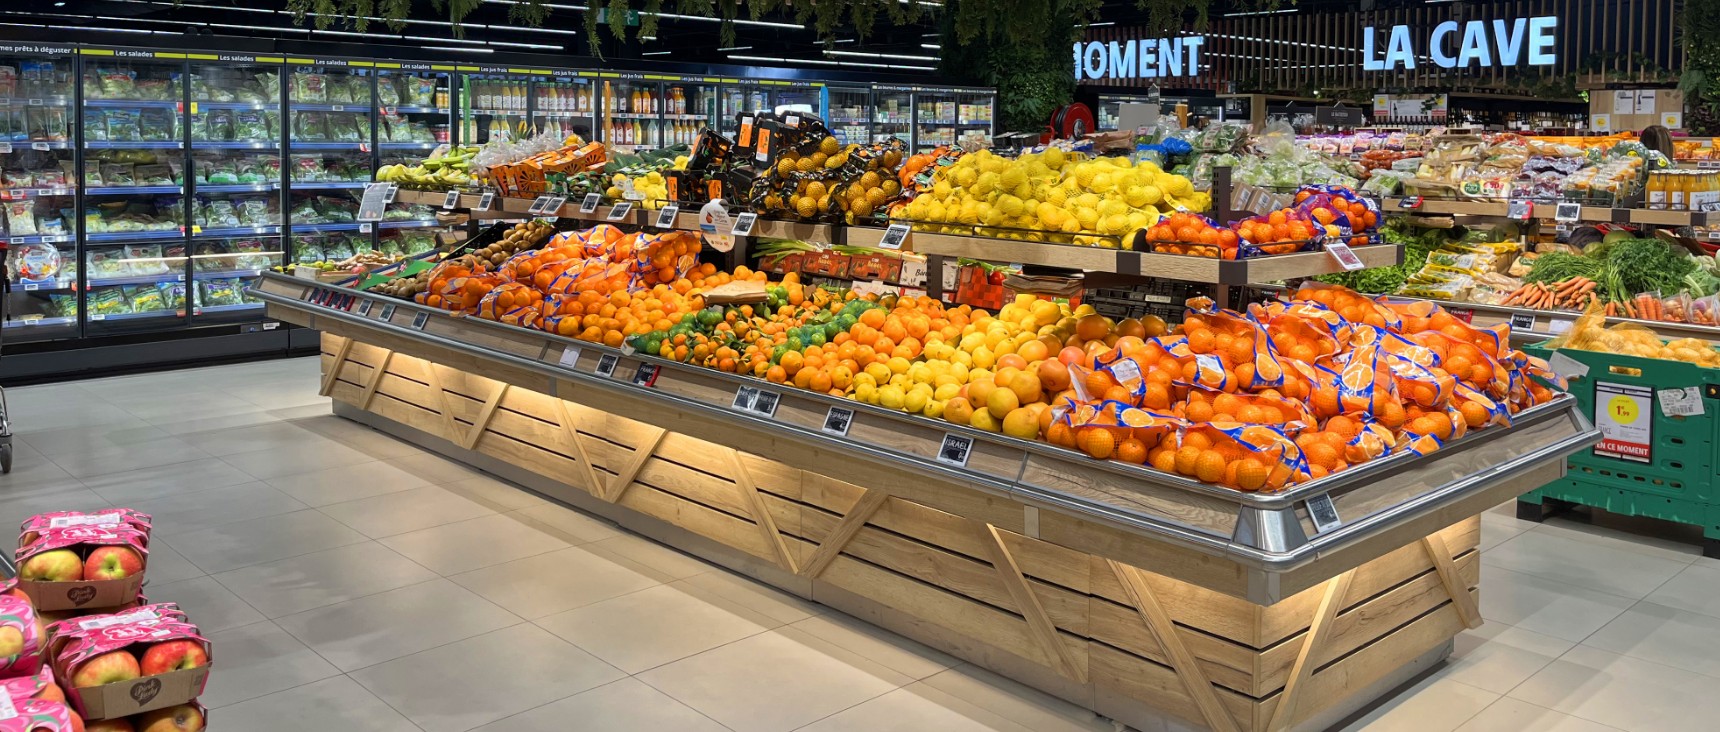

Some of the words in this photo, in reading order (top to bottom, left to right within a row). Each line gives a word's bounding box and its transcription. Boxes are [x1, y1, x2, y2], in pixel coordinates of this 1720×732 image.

[1364, 24, 1416, 71] LA
[1430, 16, 1557, 68] CAVE
[40, 46, 71, 54] déguster
[128, 50, 153, 58] salades
[945, 438, 968, 450] ISRAEL
[1606, 443, 1616, 451] CE
[1617, 444, 1649, 456] MOMENT
